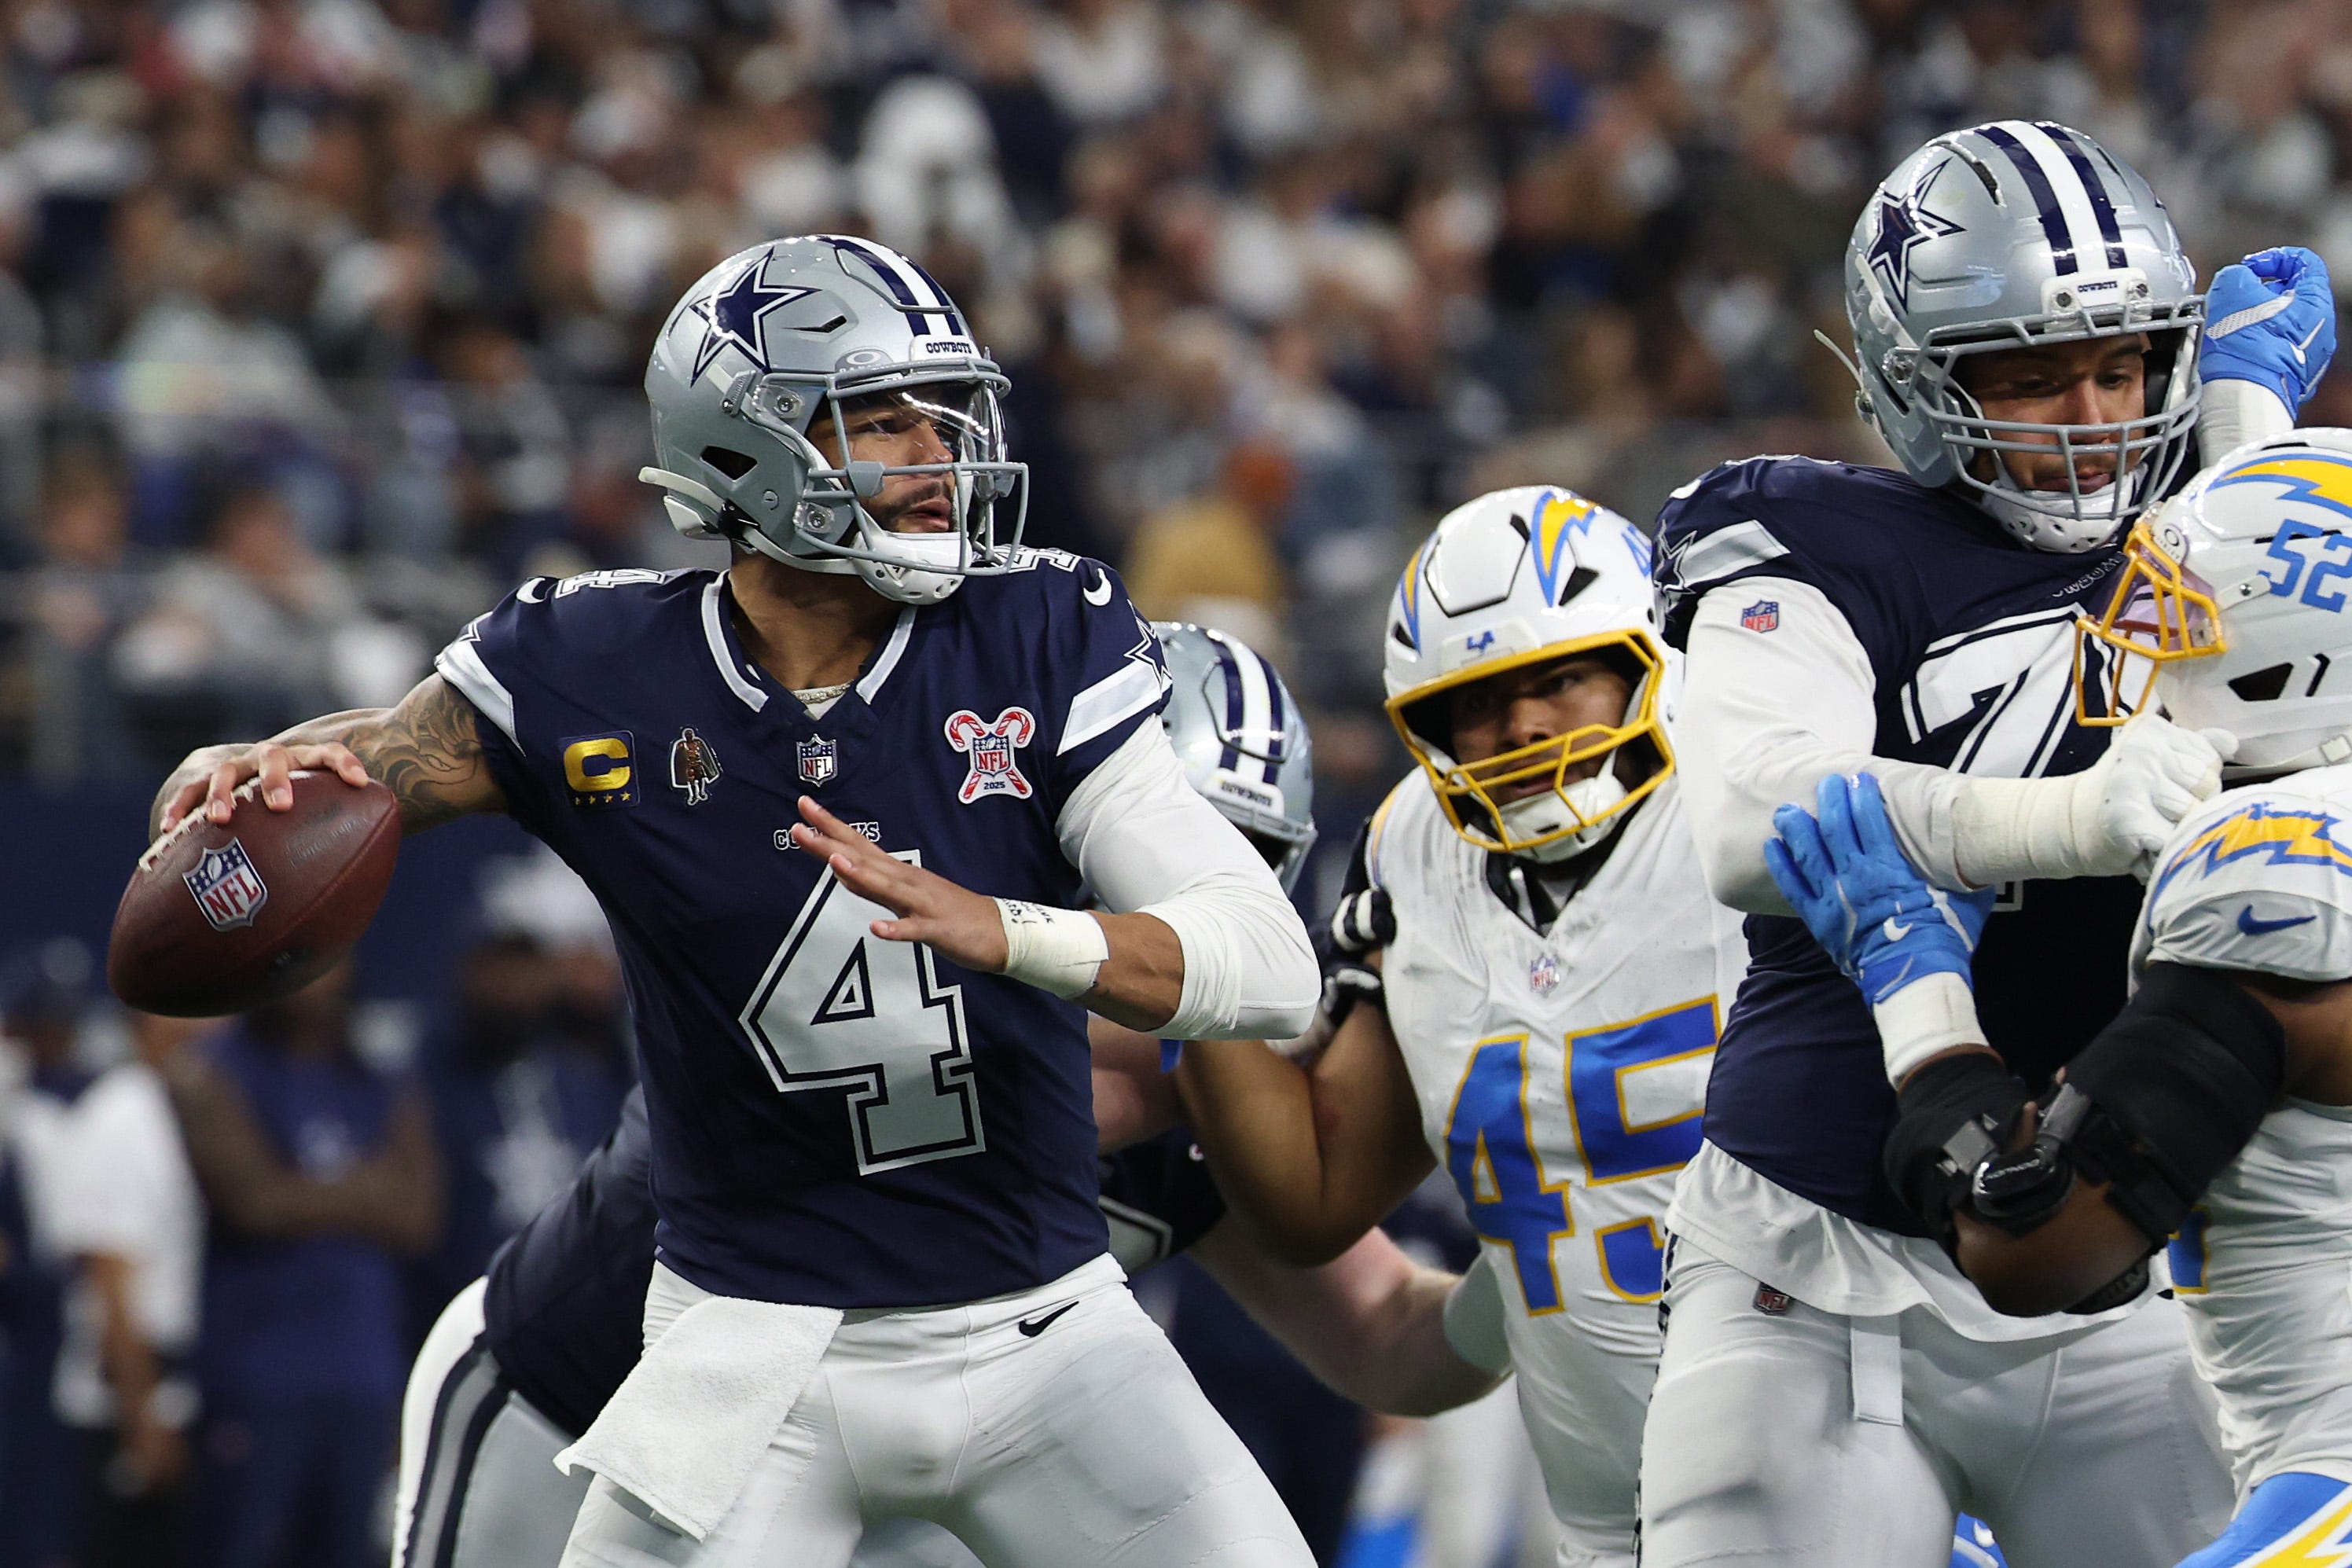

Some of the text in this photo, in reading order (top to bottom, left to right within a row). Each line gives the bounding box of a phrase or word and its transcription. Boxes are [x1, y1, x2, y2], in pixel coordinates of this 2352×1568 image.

[926, 342, 972, 354] COWBOYS
[2257, 518, 2352, 613] 52
[1745, 614, 1777, 631] NFL
[564, 737, 631, 792] C
[803, 758, 832, 777] NFL
[977, 751, 1008, 772] NFL
[983, 781, 1005, 790] 2025
[204, 872, 260, 921] NFL
[738, 849, 986, 1176] 4
[1444, 993, 1722, 1317] 45
[1758, 1292, 1788, 1312] NFL
